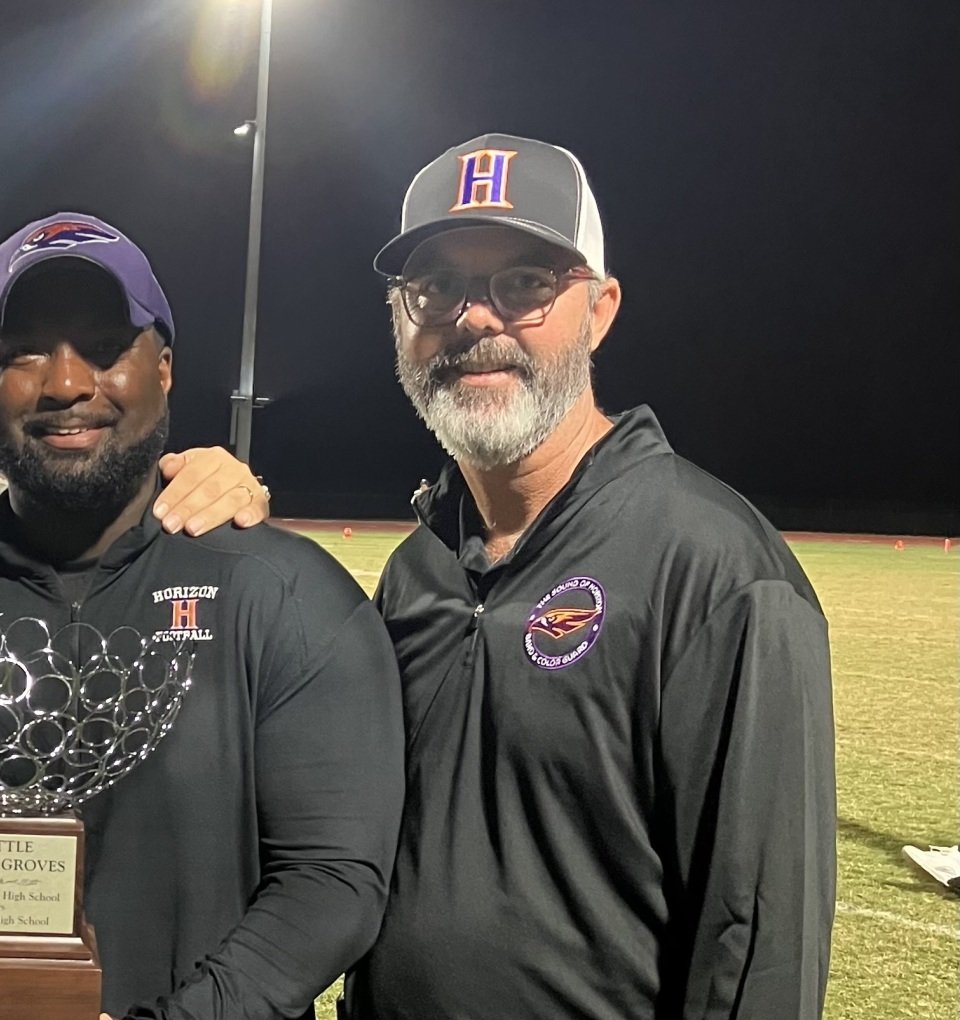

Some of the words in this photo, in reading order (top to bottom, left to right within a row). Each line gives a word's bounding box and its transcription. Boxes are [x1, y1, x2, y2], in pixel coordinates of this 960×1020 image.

[448, 148, 518, 213] H
[152, 586, 219, 604] HORIZON
[536, 593, 552, 609] THE
[551, 580, 580, 597] SOUND
[579, 580, 591, 588] OF
[170, 598, 200, 630] H
[537, 656, 561, 667] COLOR
[561, 641, 589, 664] GUARD
[1, 858, 66, 873] GROVES
[3, 891, 26, 902] High
[28, 892, 61, 902] School
[17, 916, 50, 926] School
